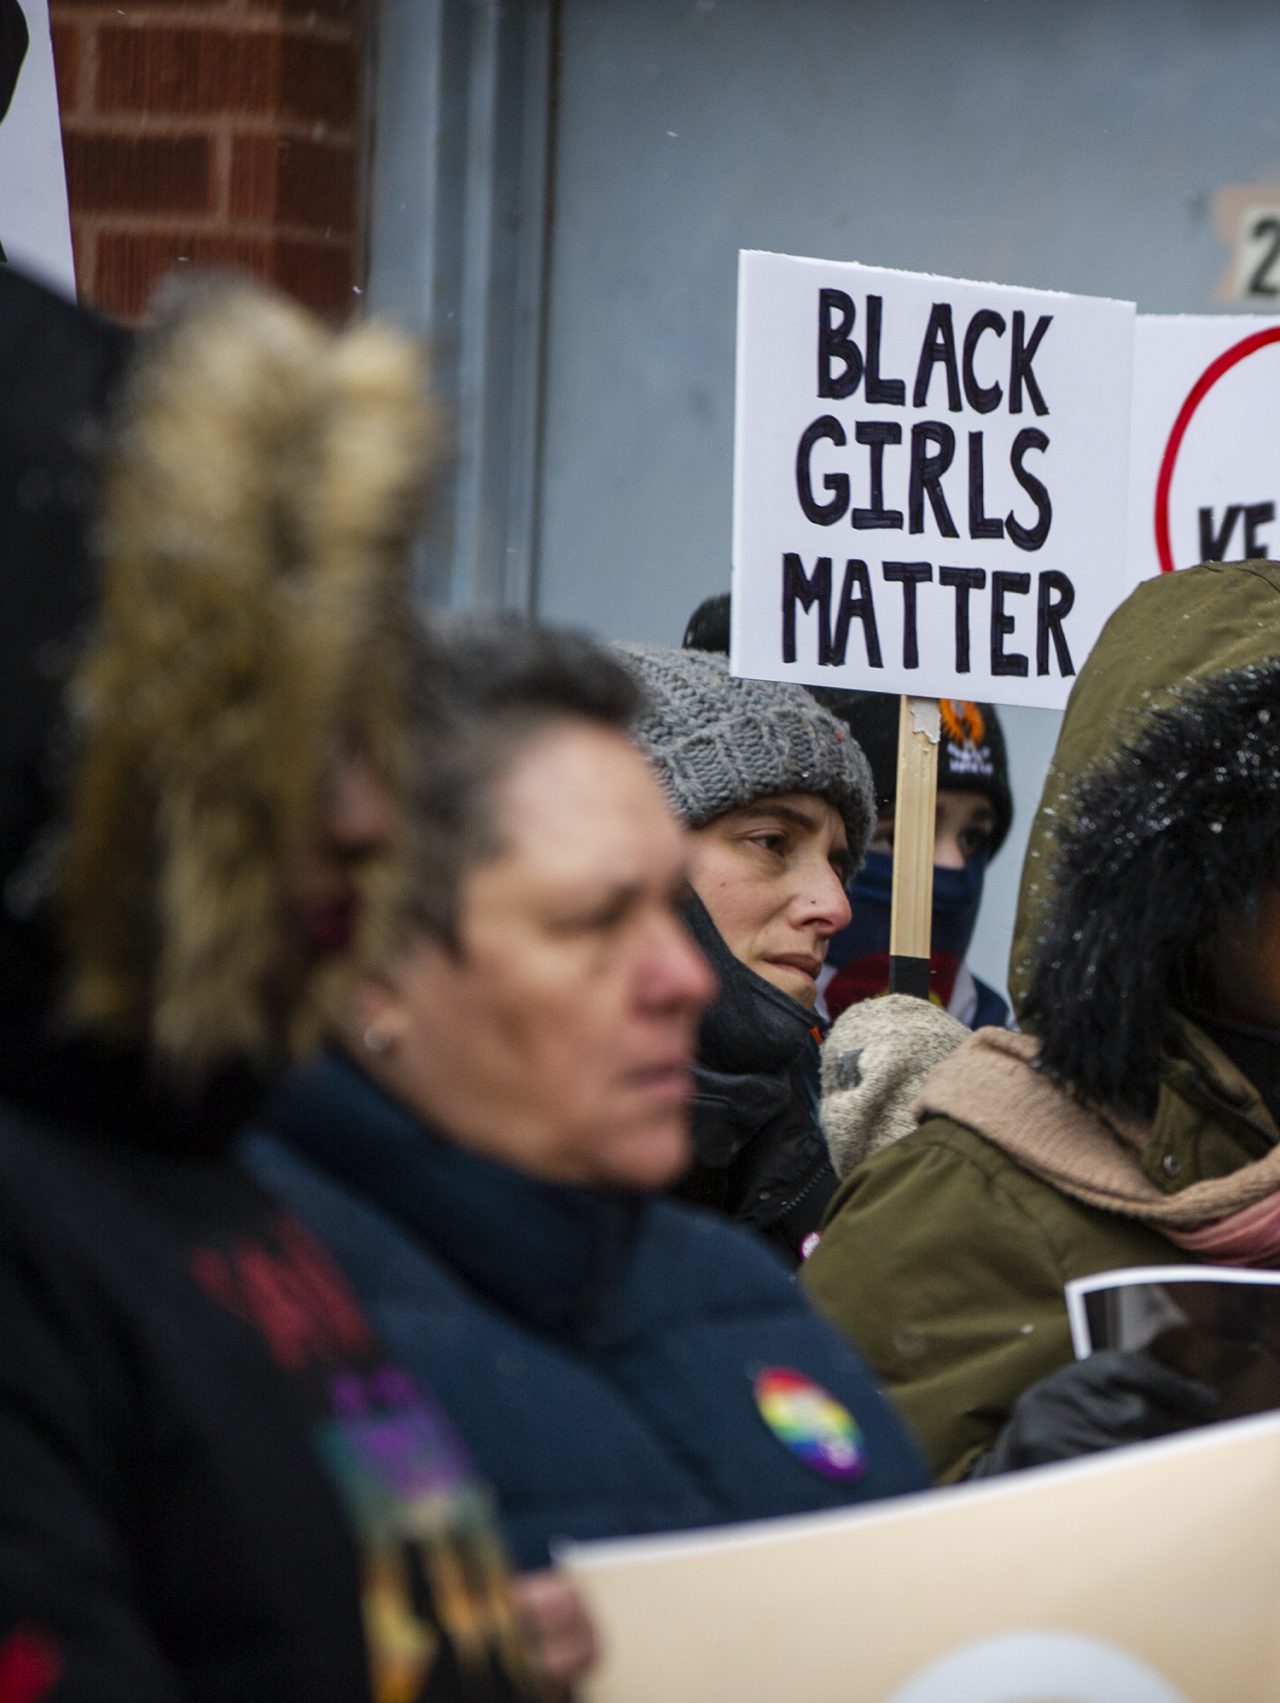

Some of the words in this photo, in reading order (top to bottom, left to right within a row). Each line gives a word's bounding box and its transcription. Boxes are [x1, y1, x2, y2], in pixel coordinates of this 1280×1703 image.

[816, 288, 1053, 416] BLACK
[796, 415, 1052, 551] GIRLS
[782, 553, 1076, 678] MATTER
